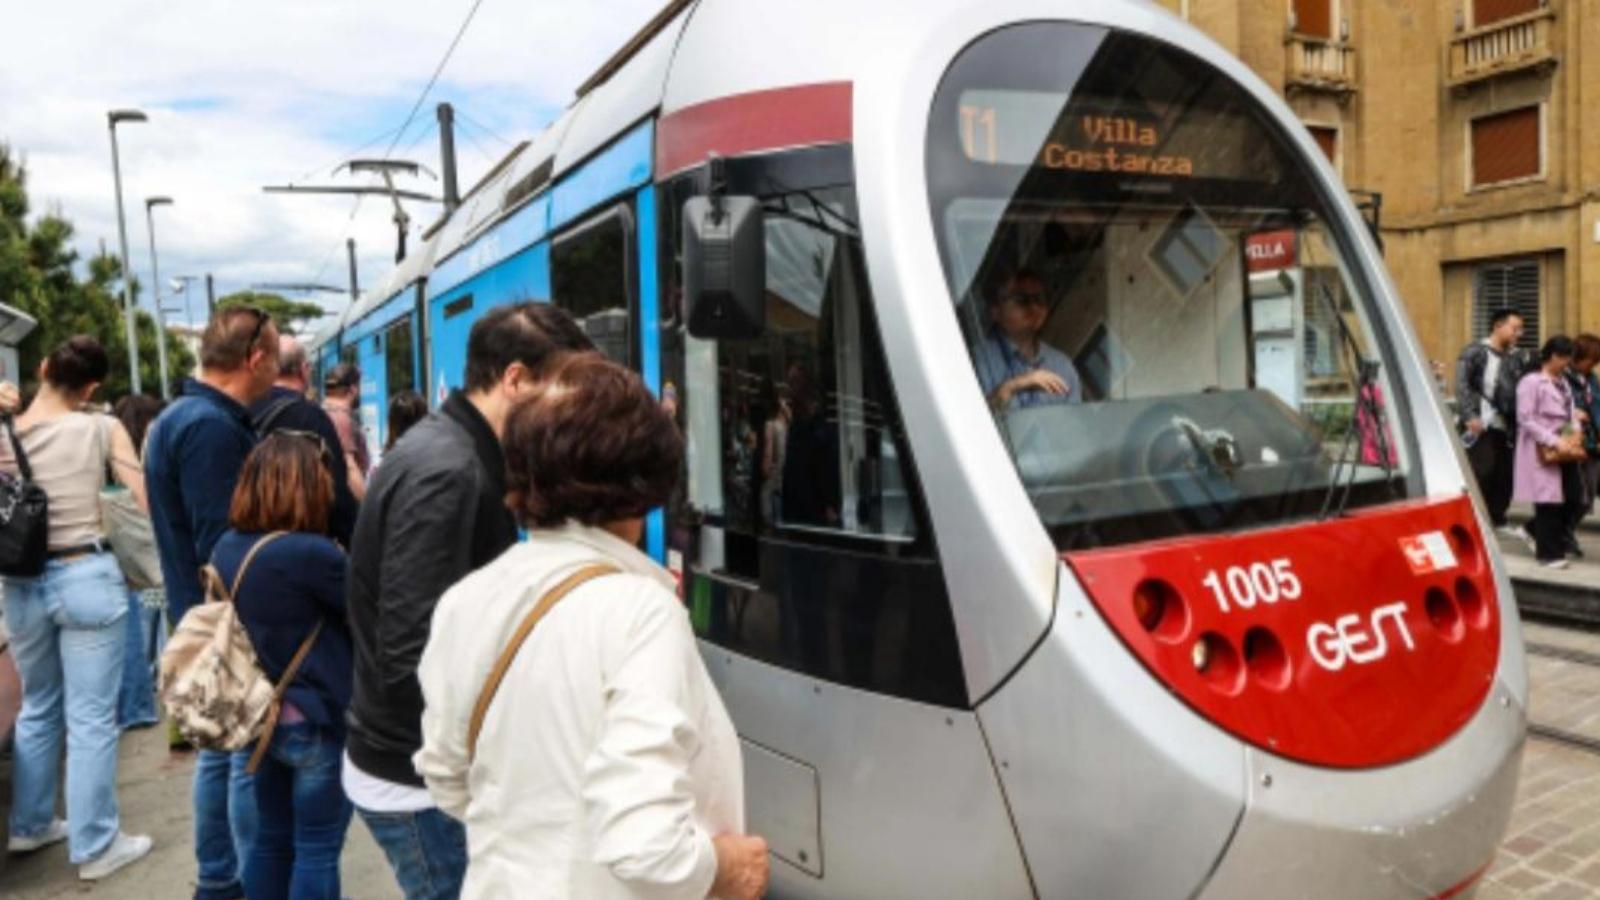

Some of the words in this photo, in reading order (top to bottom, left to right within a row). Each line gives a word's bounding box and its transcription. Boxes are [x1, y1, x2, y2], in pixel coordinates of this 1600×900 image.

[959, 105, 996, 164] T1
[1083, 116, 1157, 145] Villa
[1043, 143, 1193, 175] Costanza
[1203, 558, 1301, 612] 1005
[1306, 602, 1414, 671] GEST
